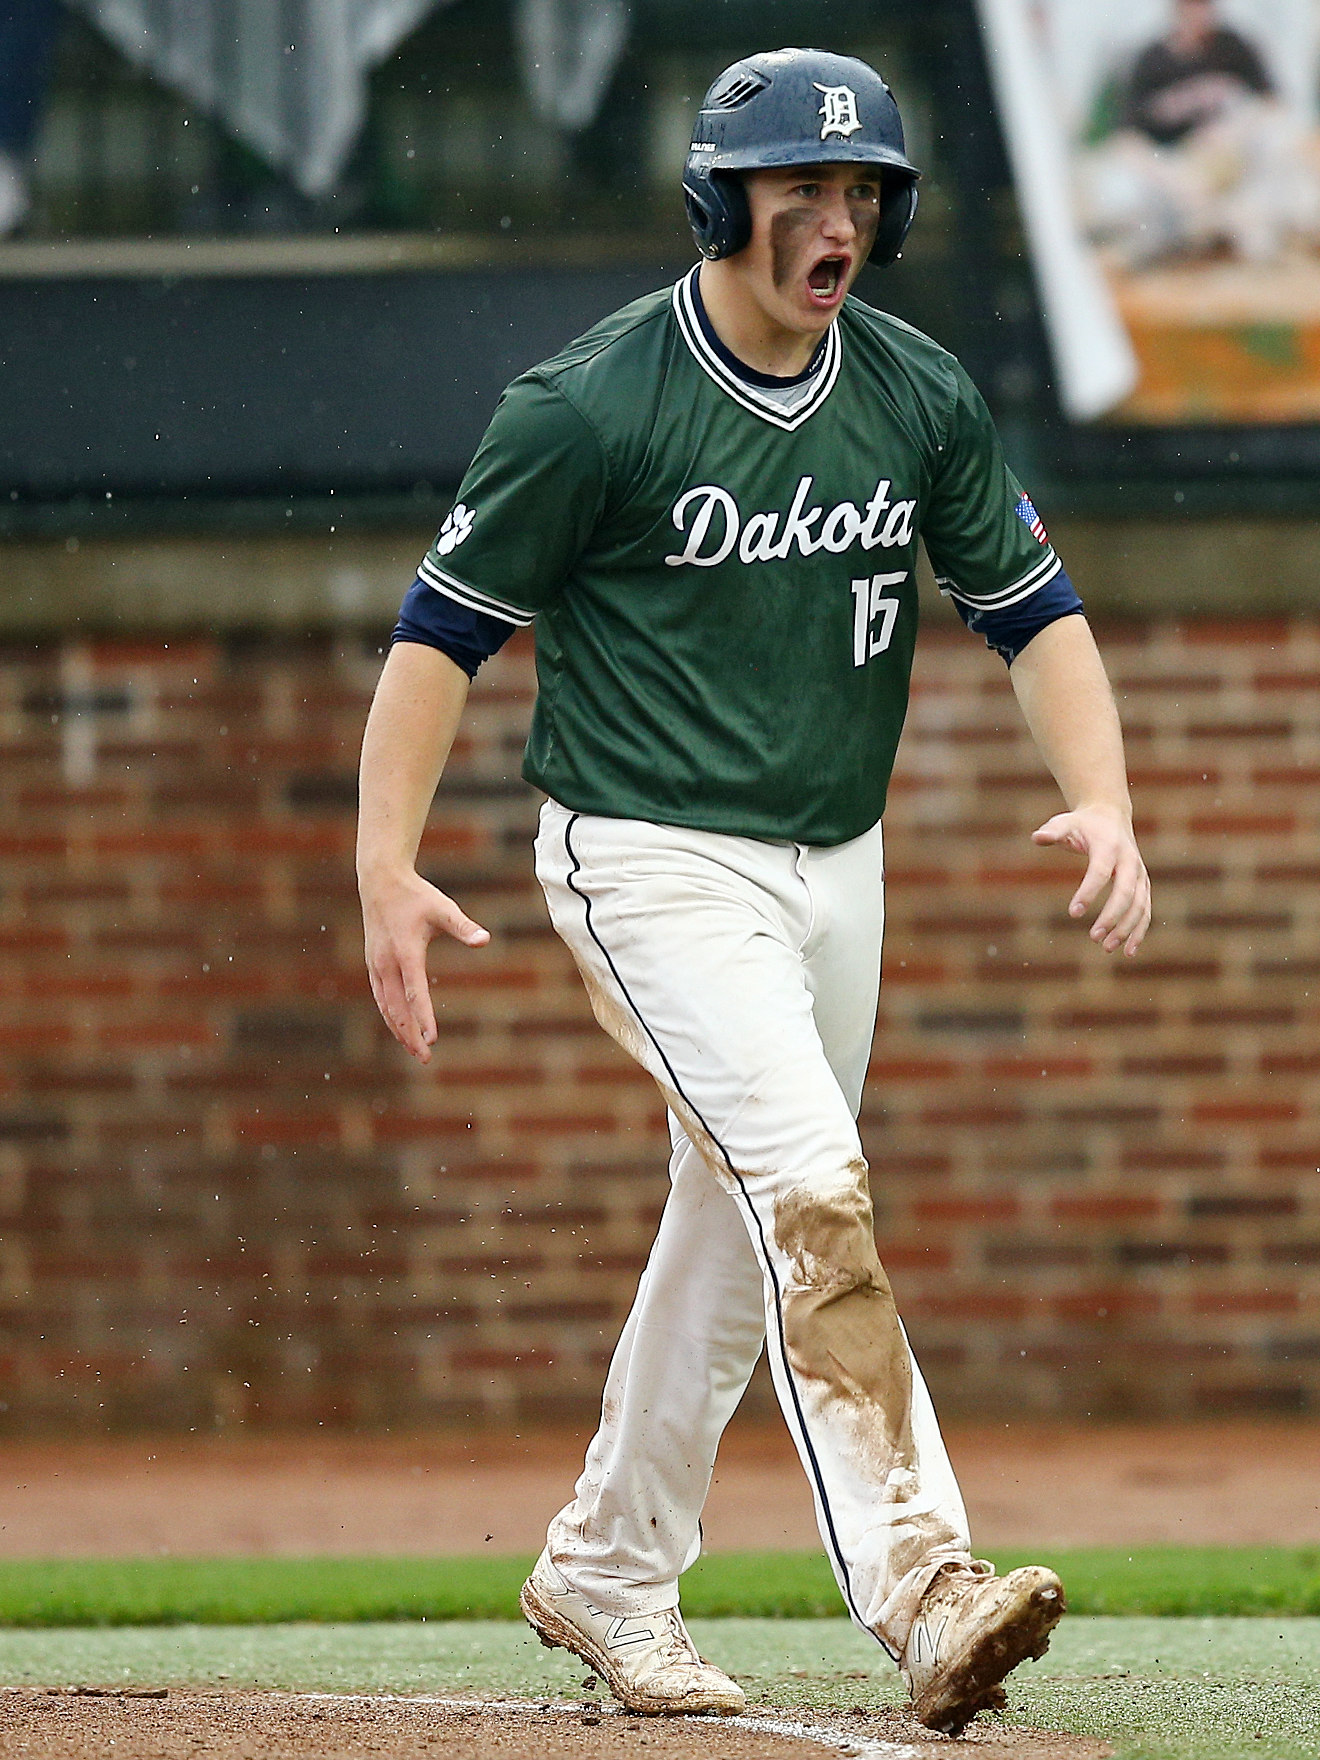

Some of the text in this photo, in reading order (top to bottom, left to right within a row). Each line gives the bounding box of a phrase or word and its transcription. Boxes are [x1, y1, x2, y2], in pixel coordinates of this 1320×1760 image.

[812, 82, 863, 141] D
[664, 475, 917, 567] Dakota
[851, 571, 909, 668] 15
